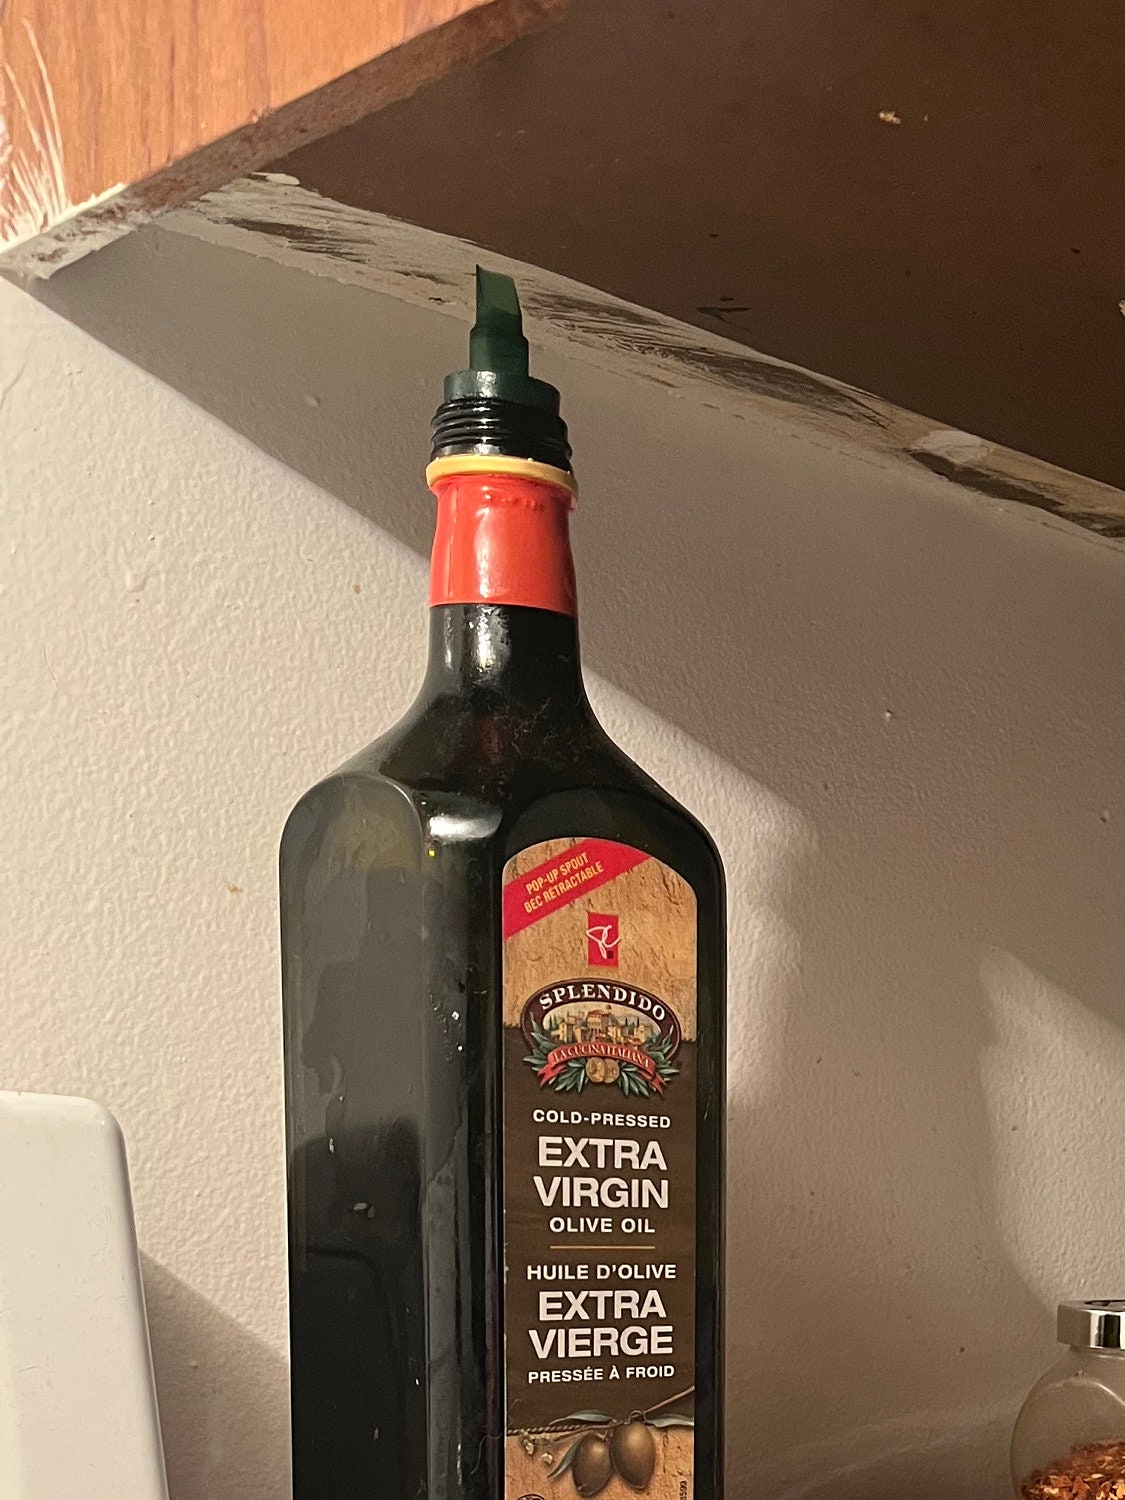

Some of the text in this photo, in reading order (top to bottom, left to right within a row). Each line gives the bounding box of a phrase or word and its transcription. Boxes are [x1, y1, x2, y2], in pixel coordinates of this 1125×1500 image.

[523, 861, 603, 913] BEC RETRACTABLE
[526, 852, 589, 895] POP-UP SPOUT
[539, 983, 666, 1021] SPLENDIDO
[532, 1109, 671, 1129] COLD-PRESSED
[538, 1136, 668, 1170] EXTRA
[533, 1176, 669, 1208] VIRGIN
[549, 1217, 656, 1233] OLIVE OIL
[527, 1264, 677, 1280] HUILE D'OLIVE
[538, 1289, 667, 1321] EXTRA
[529, 1325, 673, 1359] VIERGE
[528, 1365, 675, 1384] PRESSÉE À FROID
